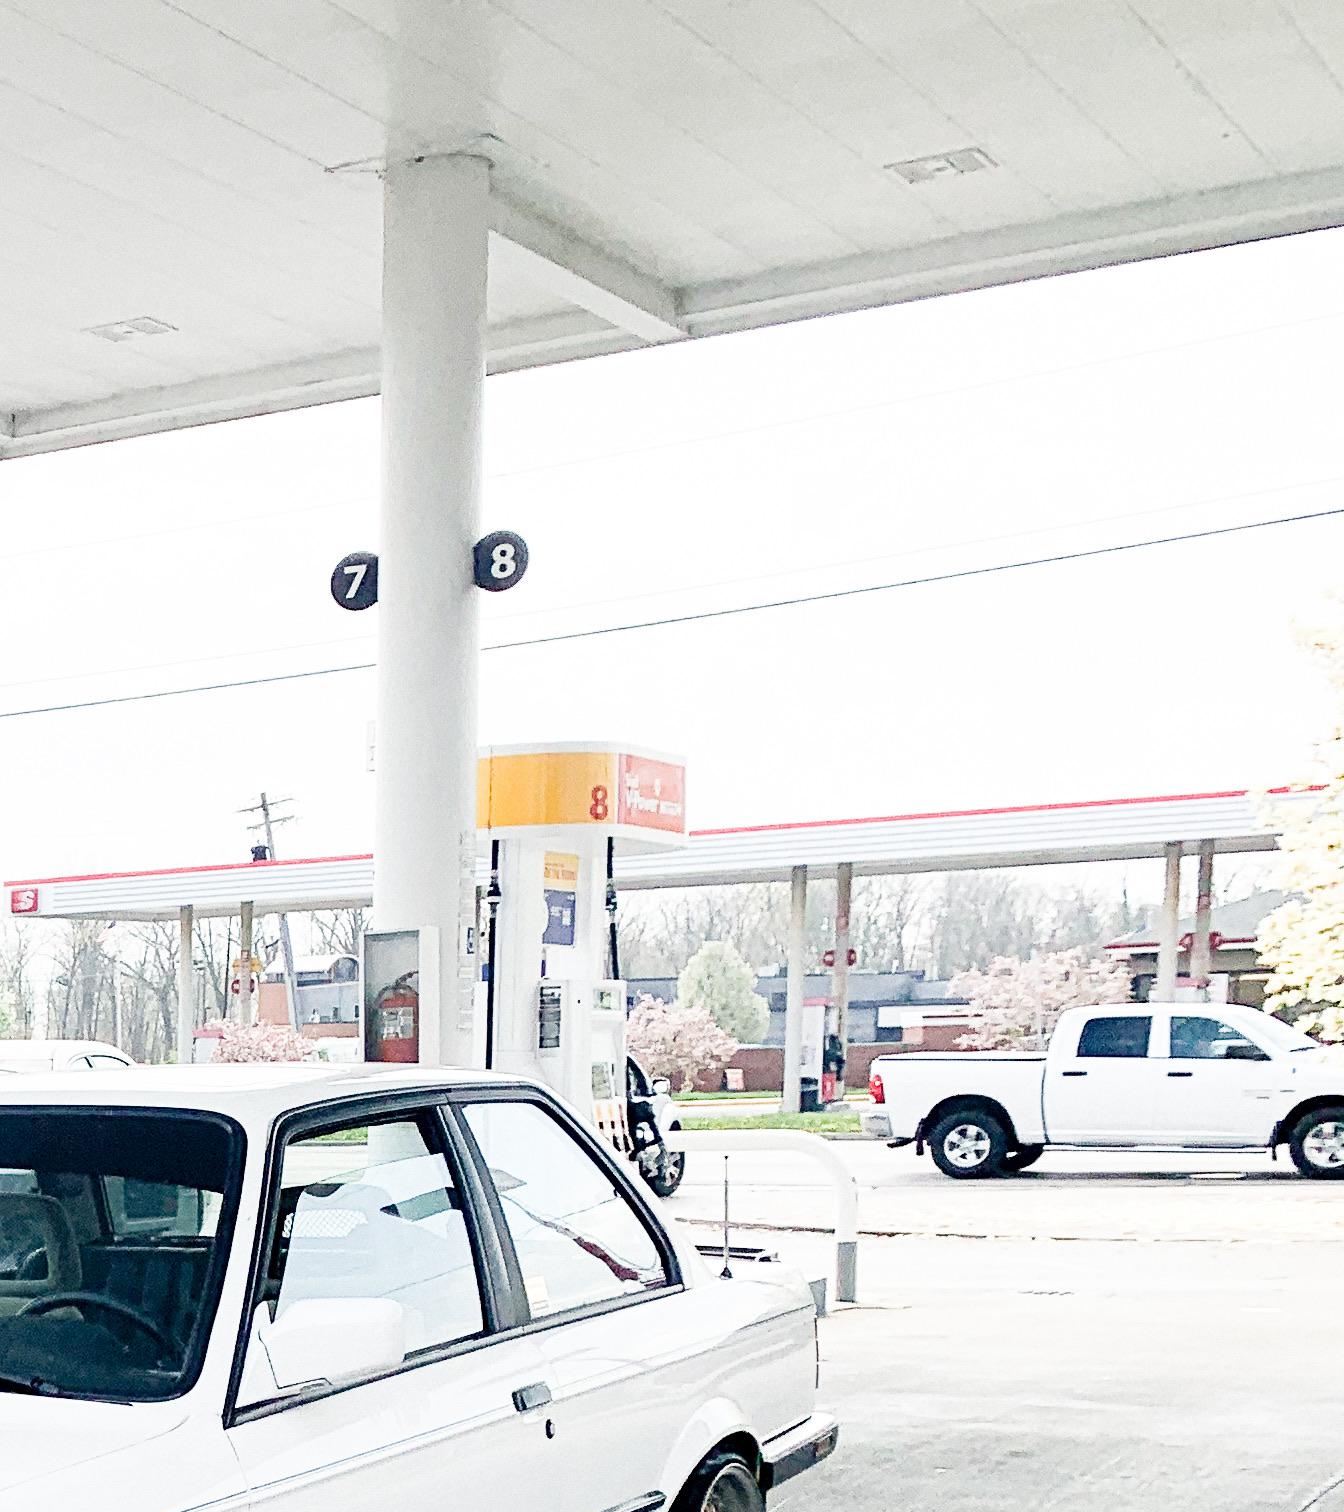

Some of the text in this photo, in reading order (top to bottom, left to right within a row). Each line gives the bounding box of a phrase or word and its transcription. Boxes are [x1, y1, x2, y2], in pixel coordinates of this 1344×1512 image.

[490, 543, 517, 579] 8
[343, 564, 368, 599] 7
[590, 784, 608, 821] 8
